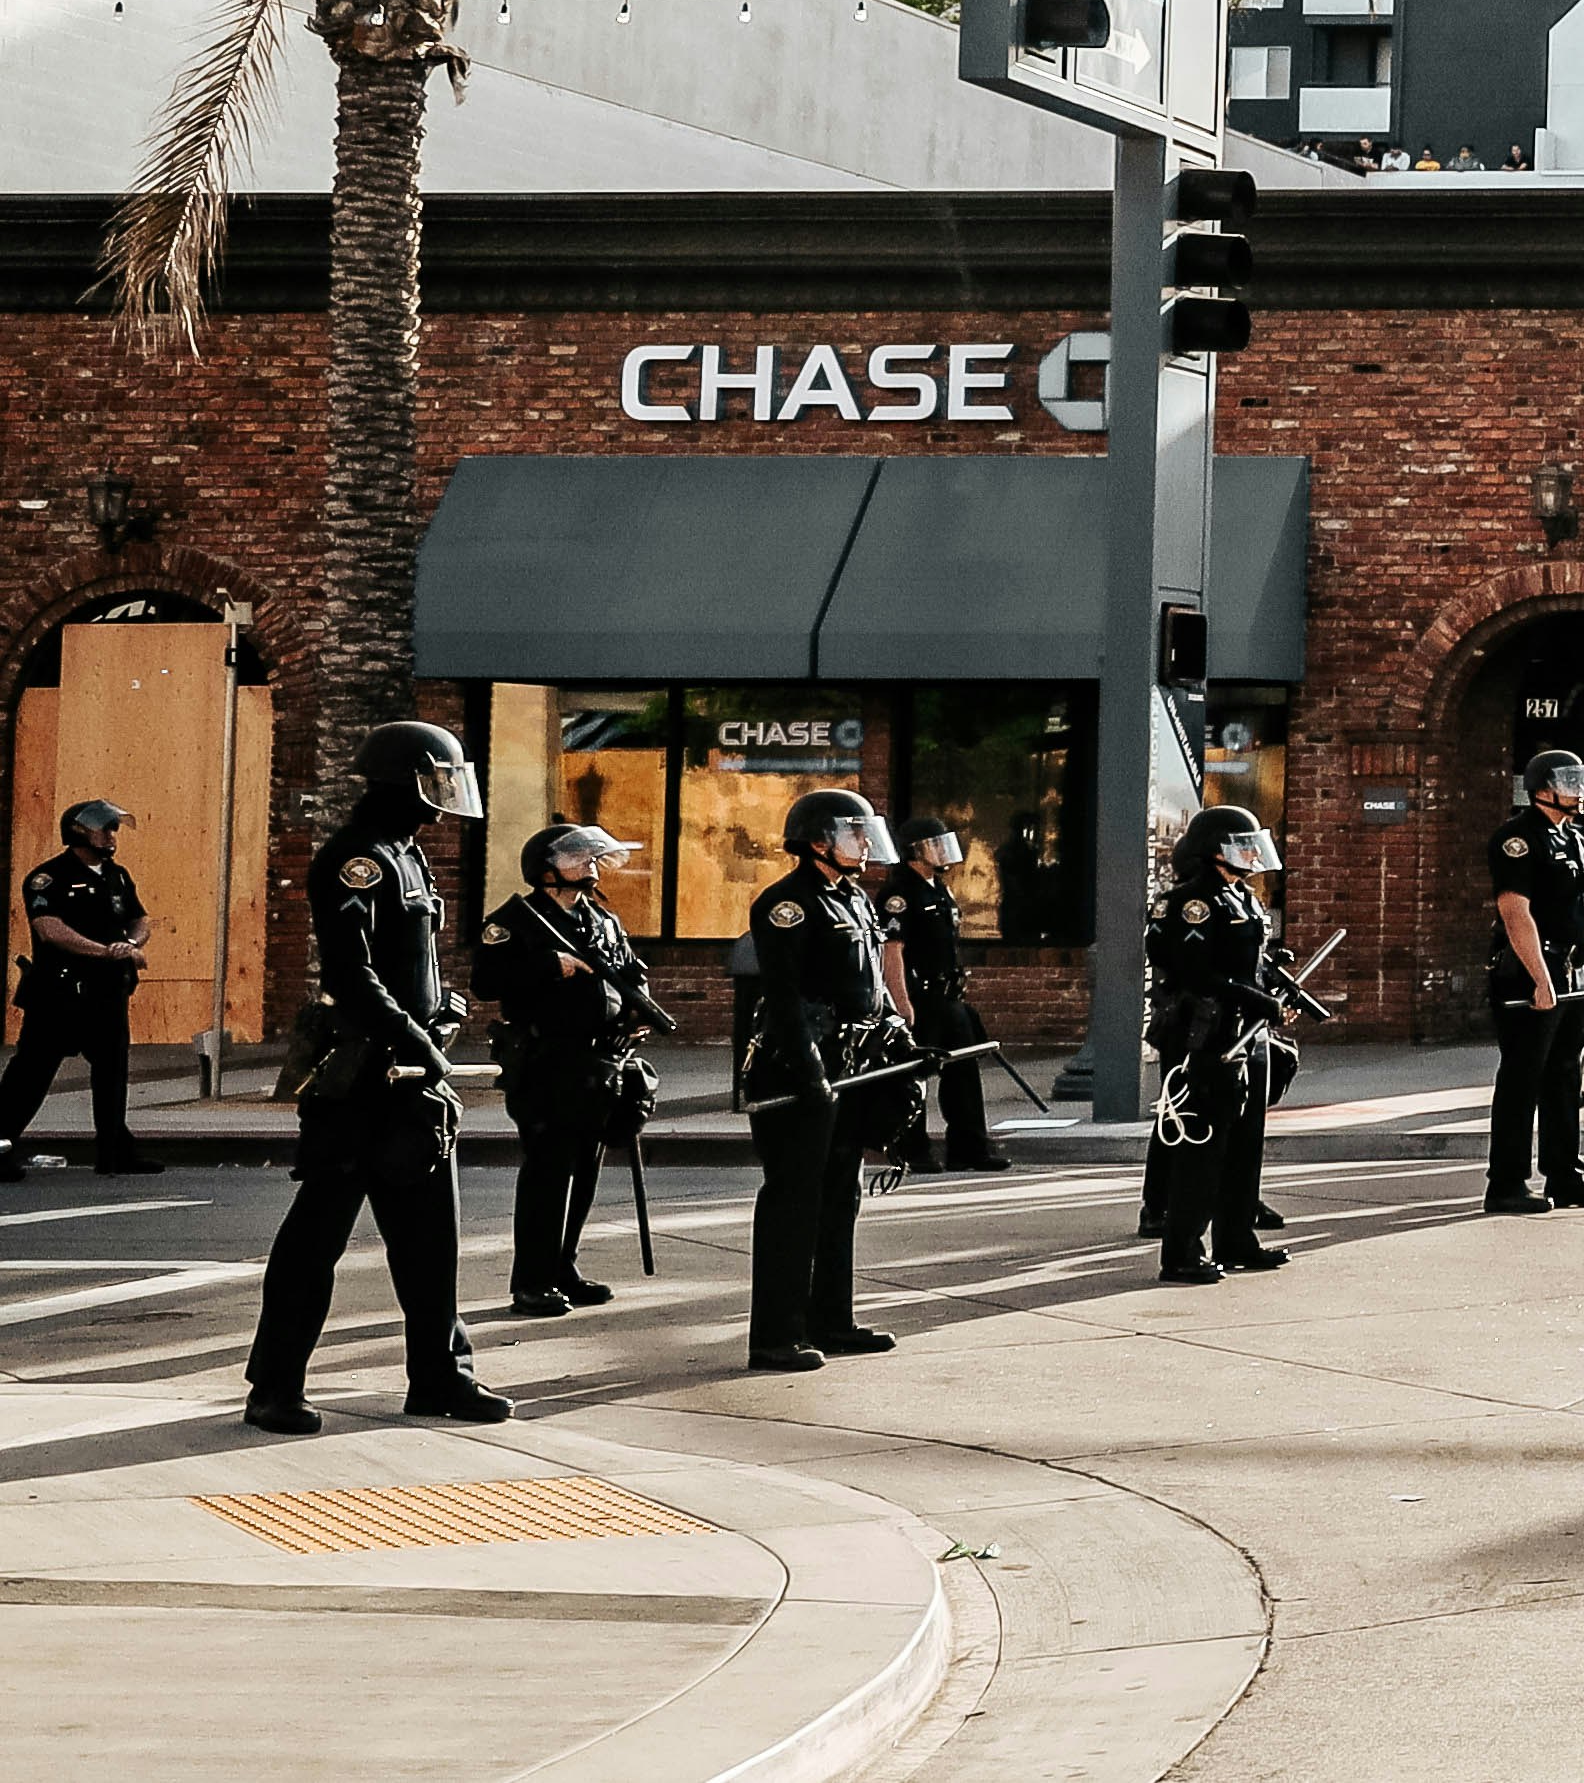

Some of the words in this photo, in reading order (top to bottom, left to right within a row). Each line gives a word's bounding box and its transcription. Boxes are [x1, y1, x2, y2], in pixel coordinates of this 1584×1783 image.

[621, 343, 1015, 421] CHASE
[1527, 698, 1559, 718] 257
[718, 721, 832, 746] CHASE
[1363, 801, 1396, 811] CHASE
